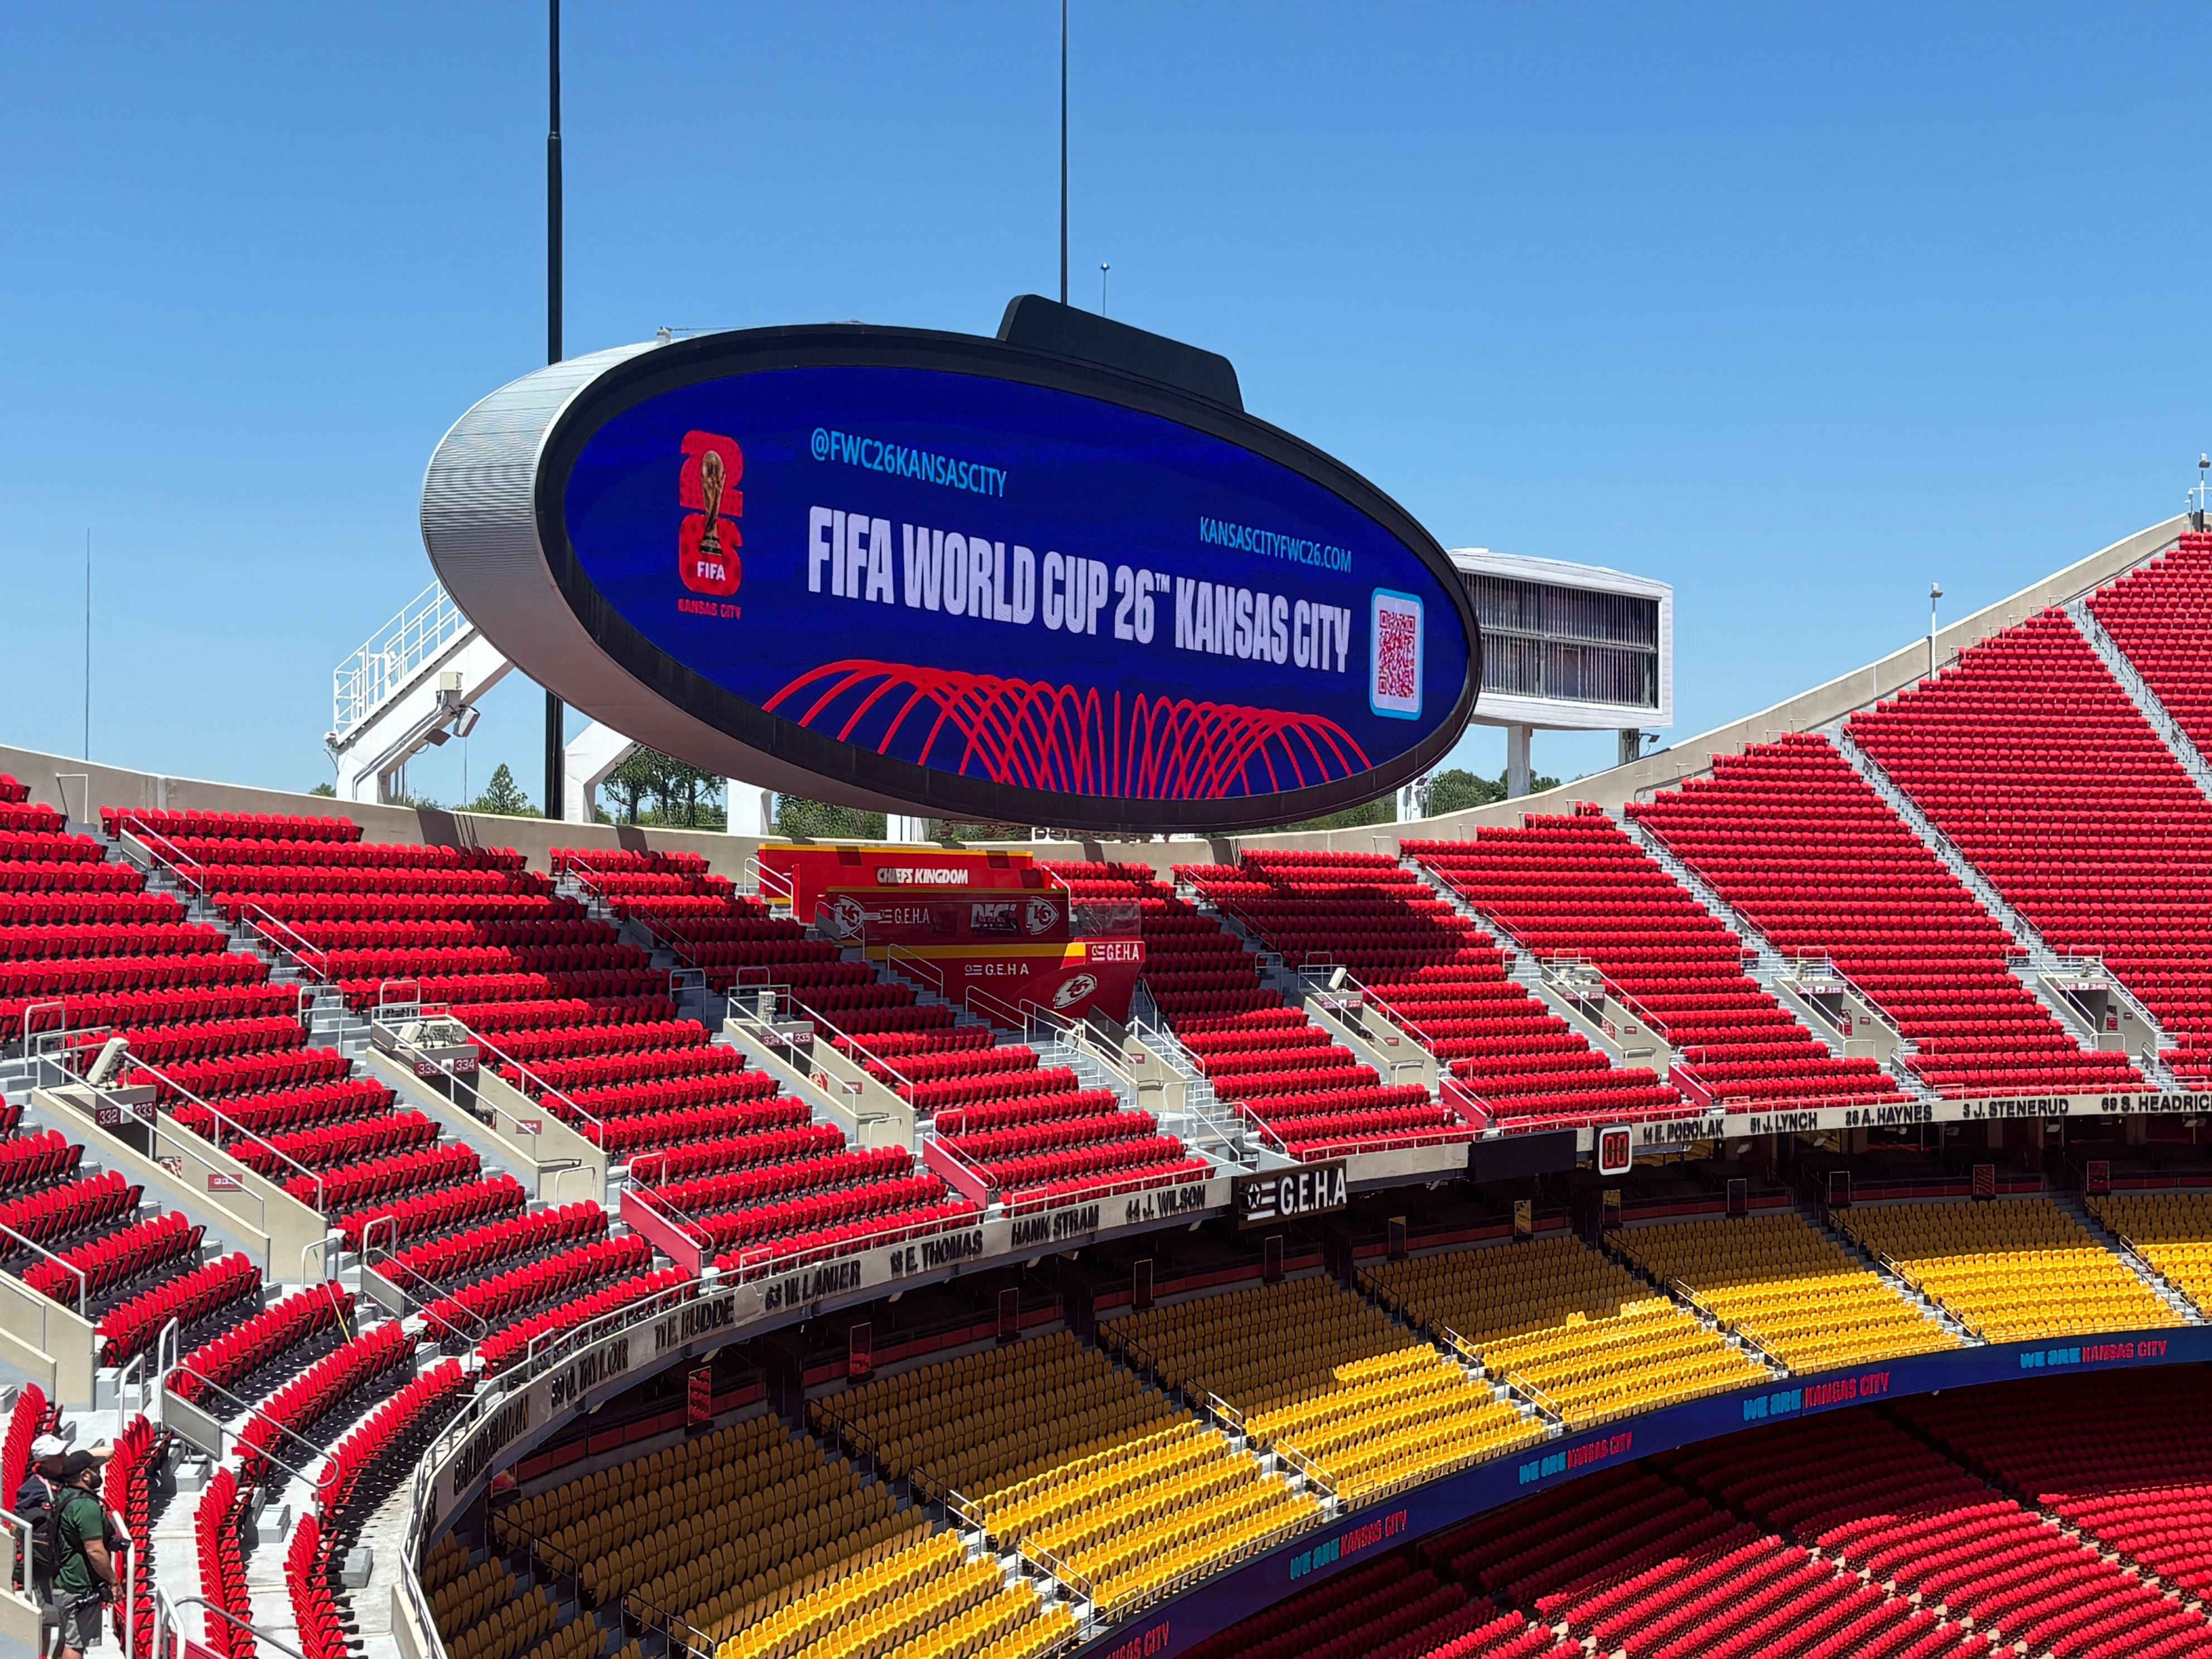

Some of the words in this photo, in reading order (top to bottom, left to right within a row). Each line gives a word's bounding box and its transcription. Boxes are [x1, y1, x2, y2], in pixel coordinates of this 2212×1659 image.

[811, 428, 1006, 497] @FWC26KANSASCITY
[1201, 517, 1352, 573] KANSASCITYFWC26.COM
[697, 561, 726, 581] FIFA
[808, 506, 894, 604] FIFA
[903, 524, 1035, 625] WORLD
[1043, 552, 1108, 635] CUP
[1175, 576, 1288, 664] KANSAS
[1293, 600, 1351, 673] CITY
[678, 599, 717, 616] KANSAS
[721, 604, 741, 620] CITY
[877, 867, 913, 884] CHIEFS
[915, 868, 968, 885] KINGDOM
[456, 1059, 475, 1071] 334
[99, 1109, 118, 1125] 332
[1862, 1108, 1875, 1126] A.
[1878, 1104, 1933, 1126] HAYNES
[1974, 1101, 1985, 1118] J.
[1989, 1098, 2069, 1117] STENERUD
[2102, 1097, 2117, 1112] 69
[2121, 1096, 2134, 1112] S.
[2139, 1094, 2212, 1112] HEADRIC
[1668, 1118, 1724, 1144] PODOLAK
[1763, 1115, 1772, 1133] J.
[1776, 1112, 1818, 1132] LYNCH
[1143, 1194, 1154, 1219] J.
[1157, 1184, 1206, 1217] WILSON
[1280, 1168, 1347, 1216] G.E.H.A
[1011, 1215, 1050, 1247] HANK
[1053, 1204, 1099, 1236] STRAM
[922, 1229, 983, 1269] THOMAS
[802, 1260, 861, 1301] LANIER
[681, 1295, 735, 1341] BUDDE
[579, 1338, 629, 1392] TAYLOR
[2021, 1352, 2045, 1369] WE
[2047, 1348, 2081, 1366] ARE
[2083, 1342, 2134, 1362] KANSAS
[2138, 1340, 2168, 1357] CITY
[1743, 1396, 1768, 1421] WE
[1770, 1388, 1803, 1415] ARE
[1805, 1378, 1857, 1409] KANSAS
[1860, 1371, 1891, 1396] CITY
[1519, 1460, 1540, 1485] WE
[1568, 1439, 1608, 1470] KANSAS
[1610, 1431, 1633, 1454] CITY
[1341, 1520, 1382, 1557] KANSAS
[1385, 1509, 1408, 1538] CITY
[1145, 1620, 1169, 1657] CITY
